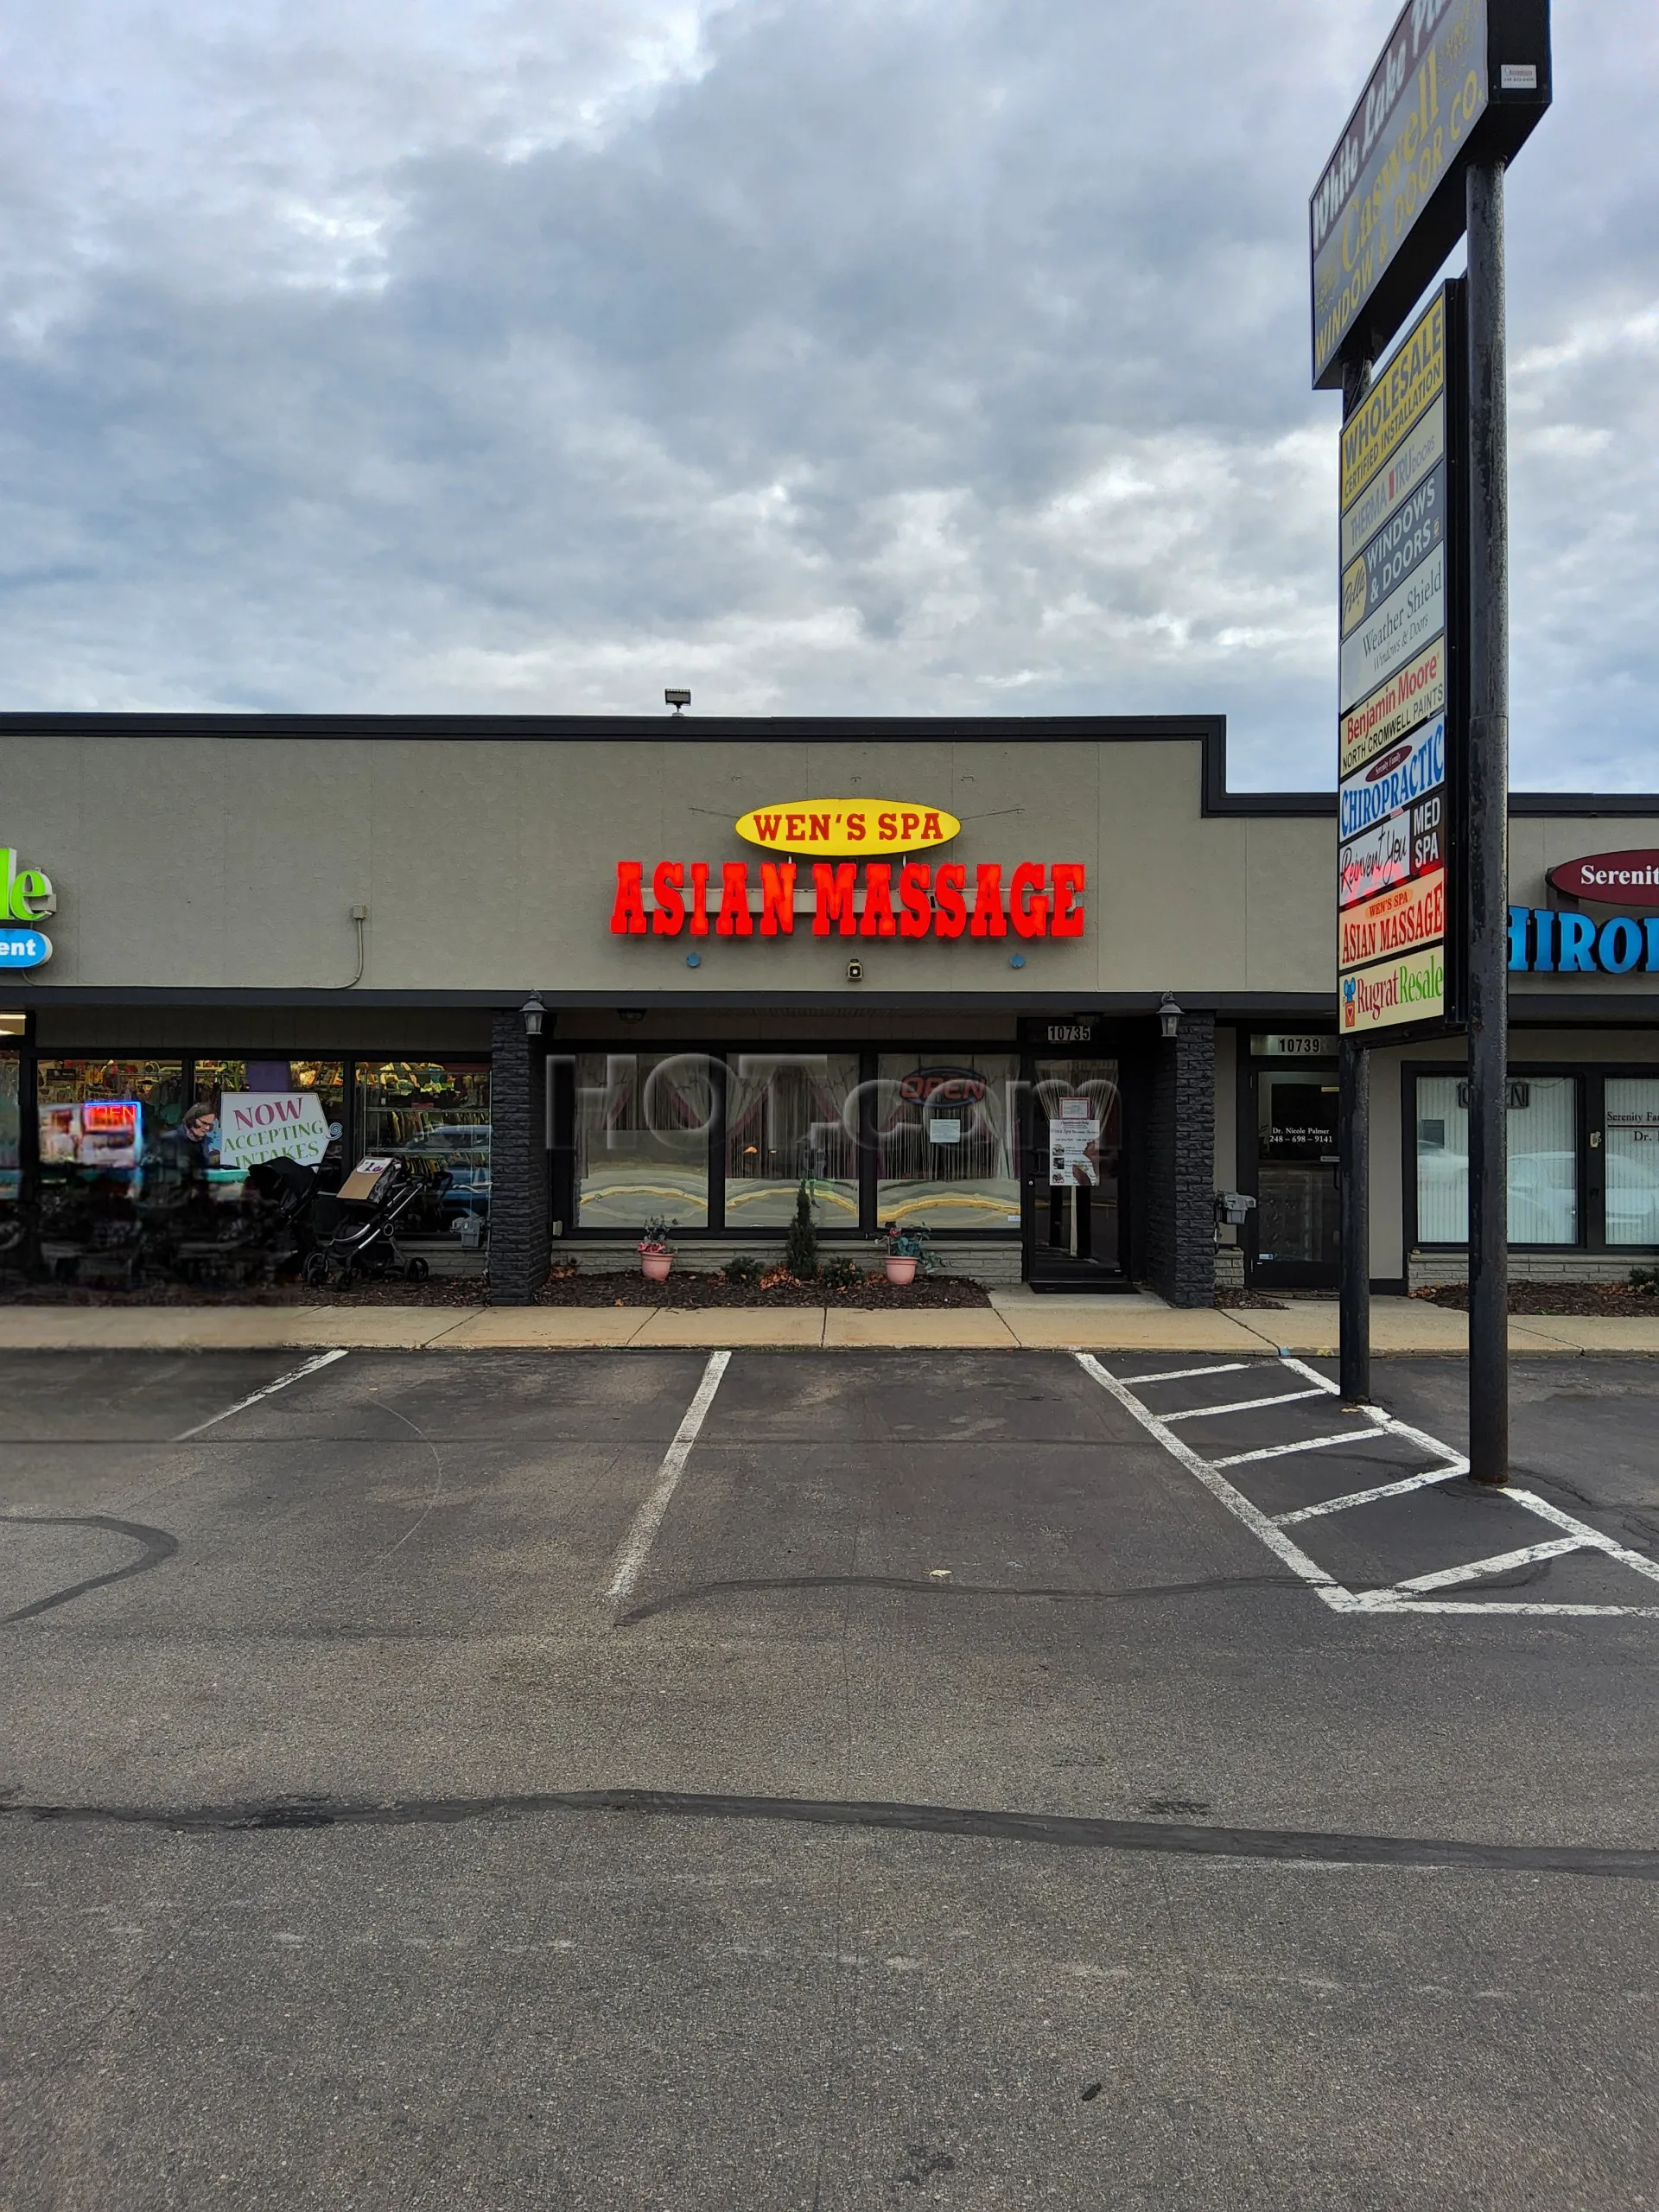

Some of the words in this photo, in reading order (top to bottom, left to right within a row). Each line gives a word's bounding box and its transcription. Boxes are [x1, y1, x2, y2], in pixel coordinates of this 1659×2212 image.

[1314, 134, 1358, 250] White
[1362, 40, 1406, 162] Lake
[1343, 47, 1438, 272] Caswell
[1316, 243, 1373, 367] WINDOW
[1395, 125, 1442, 236] DOOR
[1345, 308, 1442, 473] WHOLESALE
[1344, 442, 1378, 499] CERTIFIED
[1382, 357, 1441, 454] INSTALLATION
[1367, 477, 1435, 573] WINDOWS
[1370, 576, 1379, 603] &
[1382, 518, 1431, 591] DOORS
[1363, 608, 1404, 657] Weather
[1407, 561, 1442, 619] Shield
[1343, 741, 1366, 772] NORTH
[1368, 710, 1411, 753] CROMWELL
[1414, 683, 1443, 720] PAINTS
[1348, 686, 1395, 745] Benjamin
[1398, 656, 1437, 705] Moore
[1341, 724, 1443, 837] CHIROPRACTIC
[1414, 797, 1441, 836] MED
[753, 813, 866, 841] WEN'S
[878, 812, 944, 841] SPA
[1340, 825, 1385, 893] Reinvent
[1382, 829, 1407, 885] You
[1415, 831, 1440, 868] SPA
[610, 861, 797, 936] ASIAN
[812, 861, 1085, 938] MASSAGE
[1342, 922, 1376, 964] ASIAN
[1380, 881, 1443, 952] MASSAGE
[1369, 897, 1392, 917] WEN'S
[1395, 891, 1408, 906] SPA
[1050, 1027, 1090, 1039] 10735
[1279, 1038, 1321, 1052] 10739
[233, 1096, 303, 1130] NOW
[900, 1077, 986, 1100] OPEN
[1607, 1111, 1643, 1123] Serenity
[1646, 1111, 1659, 1122] Fa
[224, 1120, 323, 1153] ACCEPTING
[235, 1141, 320, 1166] INTAKES
[1633, 1130, 1652, 1141] Dr.
